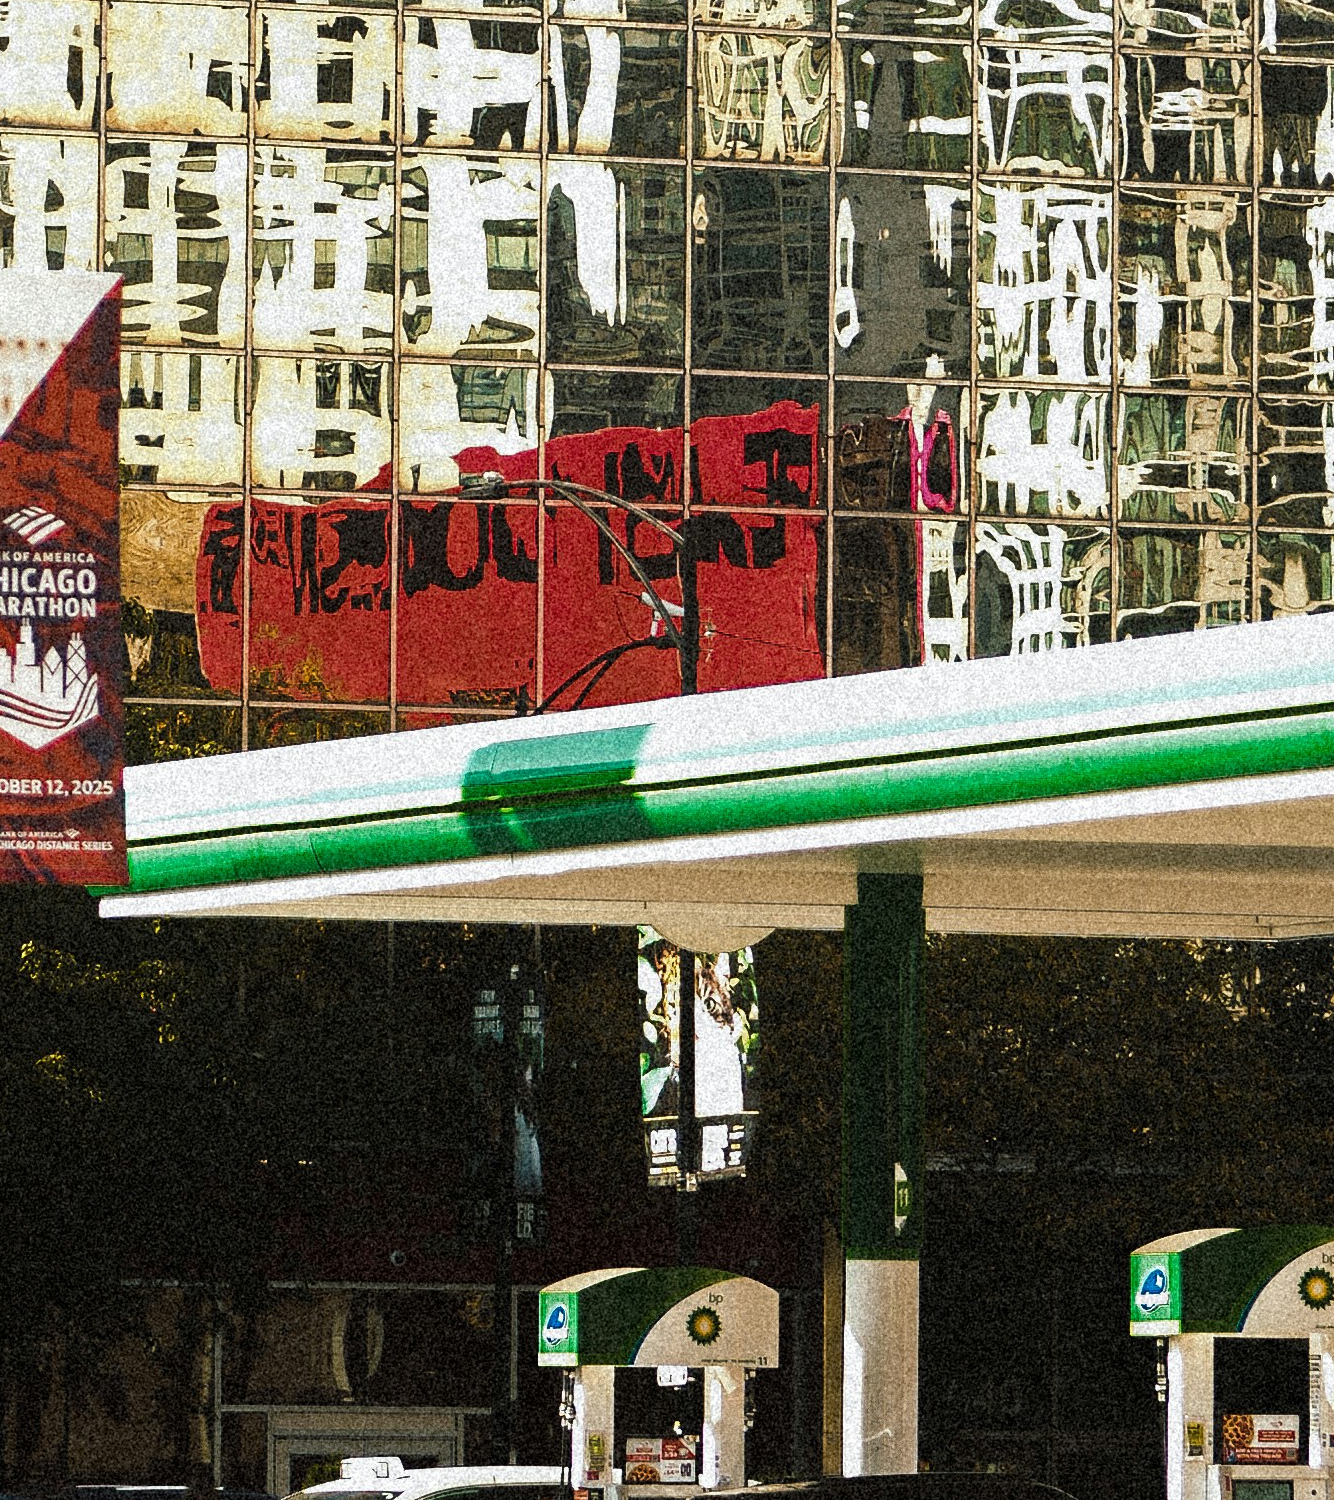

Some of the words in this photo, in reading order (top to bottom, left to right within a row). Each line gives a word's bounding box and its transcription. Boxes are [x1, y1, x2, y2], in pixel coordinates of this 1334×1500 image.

[12, 551, 30, 562] OF
[32, 551, 96, 564] AMERICA
[45, 779, 69, 797] 12,
[71, 780, 115, 796] 2025
[36, 840, 80, 851] DISTANCE
[81, 841, 115, 852] SERIES
[708, 1292, 724, 1306] bp
[757, 1356, 768, 1366] 11
